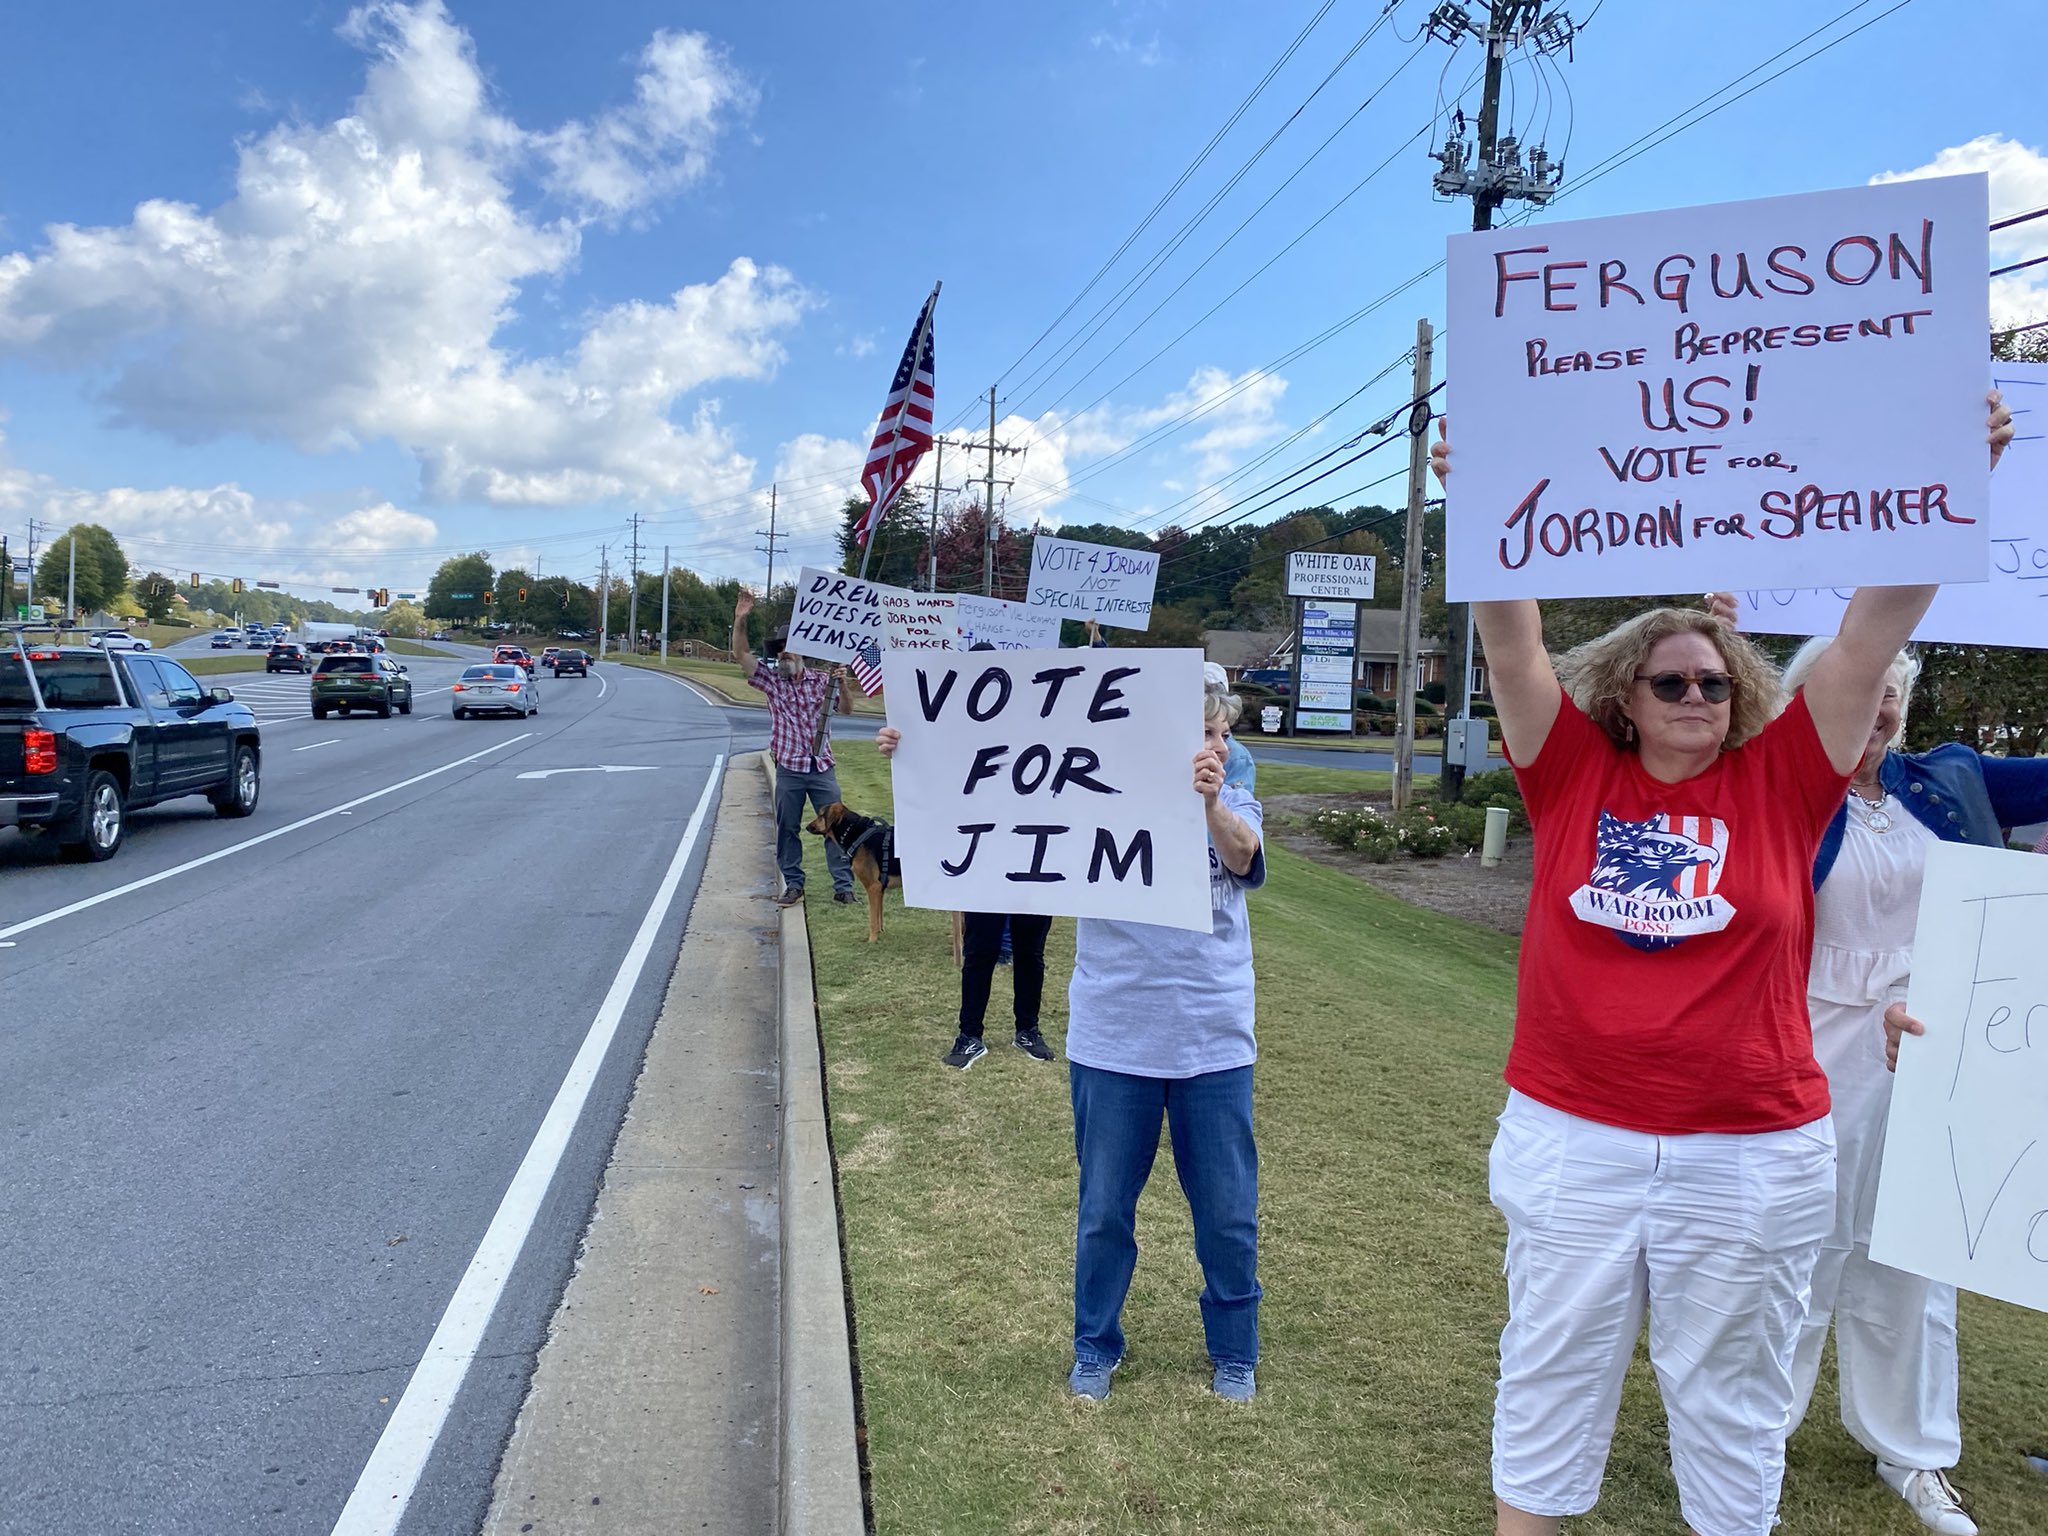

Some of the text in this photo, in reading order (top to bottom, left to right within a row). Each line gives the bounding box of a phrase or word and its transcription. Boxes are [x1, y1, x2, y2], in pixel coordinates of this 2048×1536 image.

[1494, 219, 1933, 317] FERGUSON
[1525, 310, 1933, 377] PLEASE REPRESENT
[1638, 364, 1762, 432] US!
[1597, 444, 1722, 482] VOTE
[1499, 478, 1977, 571] JORDAN FOR SPEAKER
[1036, 543, 1155, 575] VOTE 4 JORDAN
[1294, 553, 1372, 572] WHITE OAK
[810, 576, 880, 607] DREW
[1080, 576, 1121, 590] NOT
[1294, 573, 1369, 586] PROFESSIONAL
[1311, 585, 1350, 596] CENTER
[799, 596, 882, 627] VOTES FO
[916, 598, 955, 608] WANTS
[1030, 587, 1152, 614] SPECIAL INTERESTS
[887, 611, 942, 625] JORDAN
[1016, 628, 1047, 638] VOTE
[792, 620, 876, 653] HIMSE
[915, 666, 1142, 724] VOTE
[963, 743, 1123, 798] FOR
[940, 823, 1153, 887] JIM
[1589, 890, 1715, 922] WAR ROOM
[1624, 918, 1674, 934] POSSE
